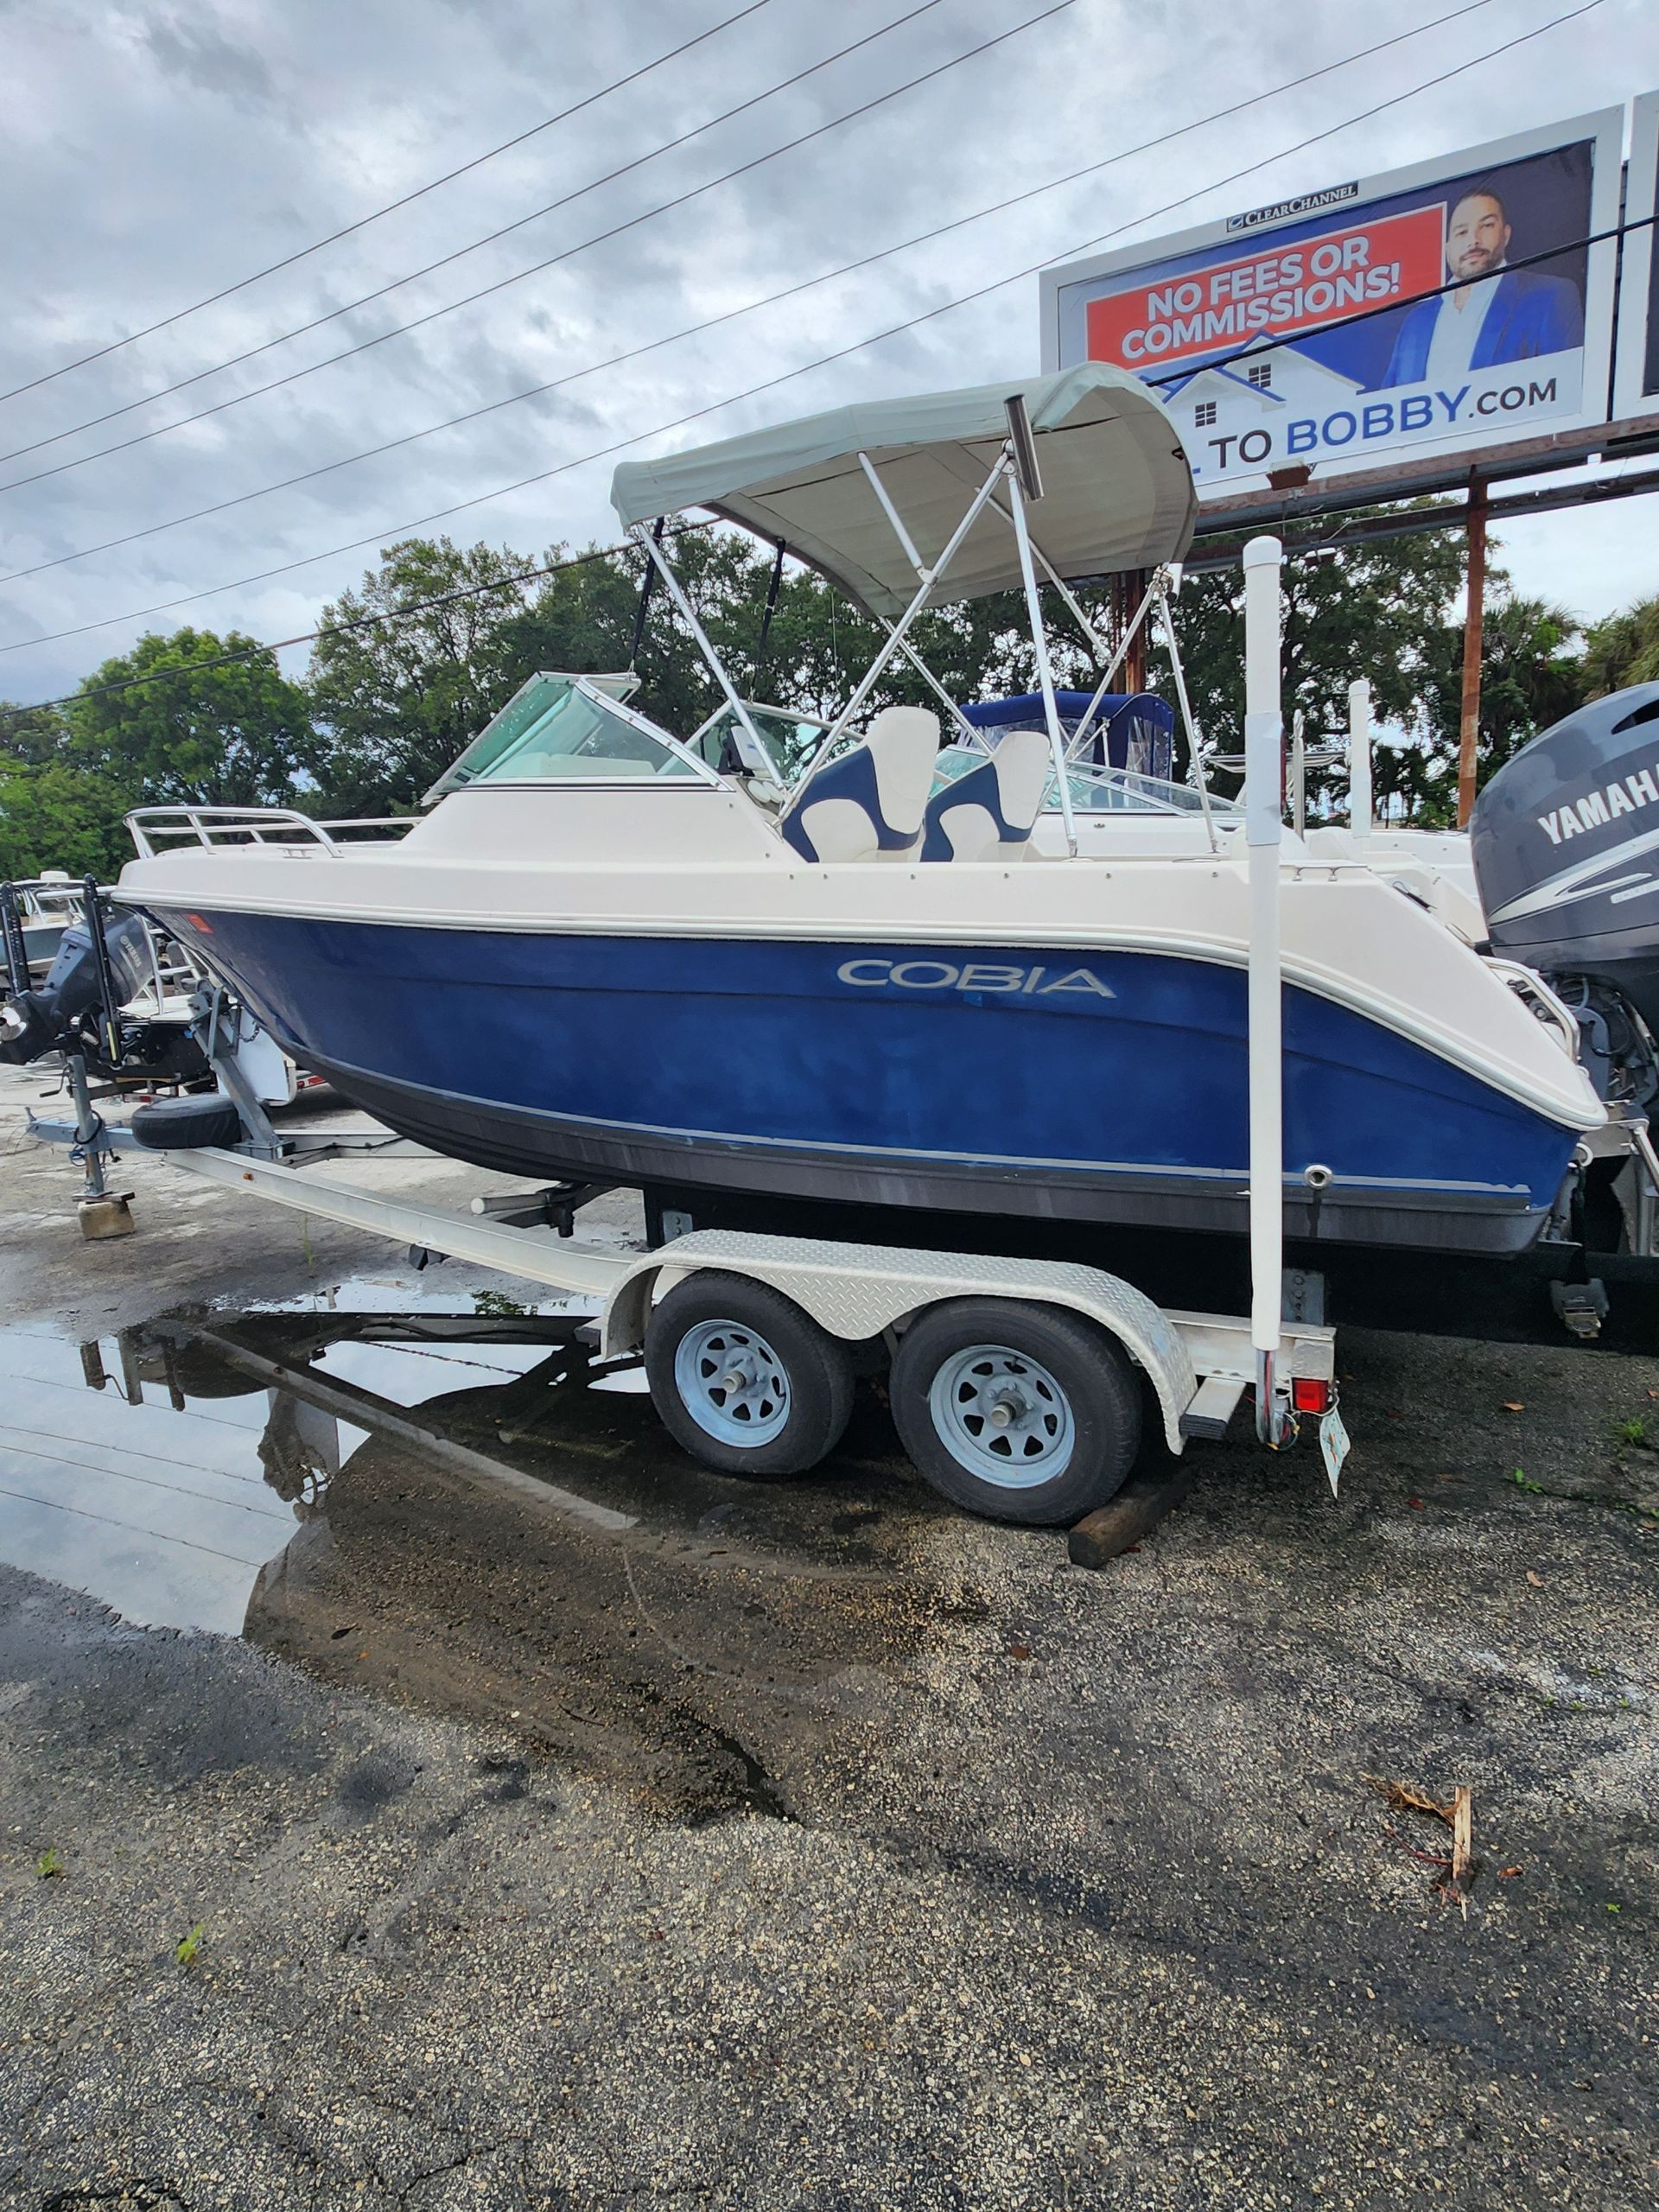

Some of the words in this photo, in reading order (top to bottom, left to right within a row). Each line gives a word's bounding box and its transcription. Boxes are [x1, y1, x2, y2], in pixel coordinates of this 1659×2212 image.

[1121, 262, 1401, 360] COMMISSIONS!
[1147, 281, 1204, 323] NO
[1211, 251, 1304, 307] FEES
[1310, 235, 1370, 277] OR
[1208, 429, 1273, 469] TO
[1536, 762, 1659, 846] YAMAH
[836, 959, 1118, 1000] COBIA
